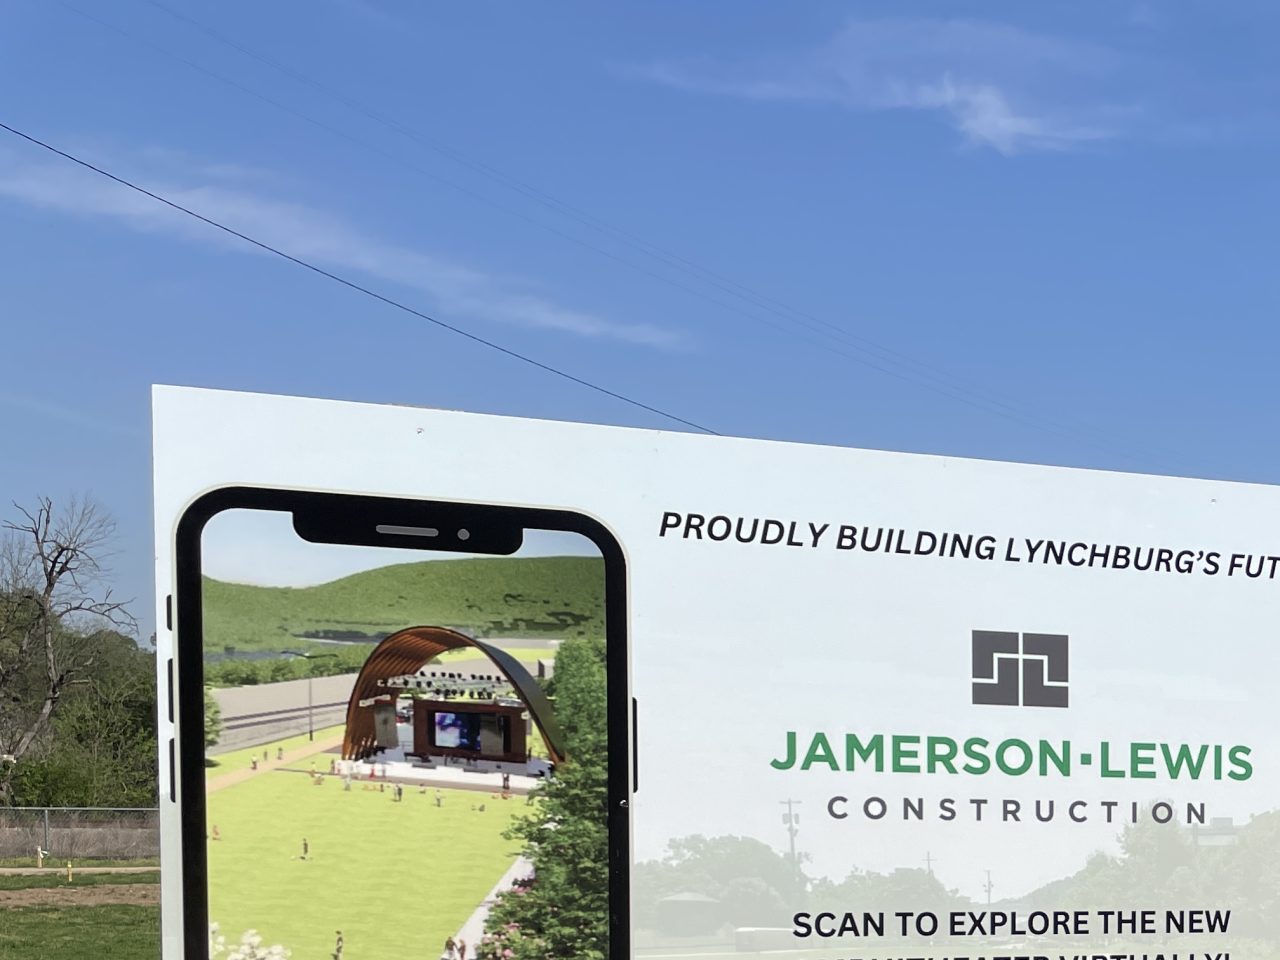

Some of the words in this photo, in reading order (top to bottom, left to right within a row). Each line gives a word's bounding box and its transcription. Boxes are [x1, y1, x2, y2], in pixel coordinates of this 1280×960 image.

[658, 511, 830, 548] PROUDLY
[835, 524, 998, 560] BUILDING
[827, 795, 1206, 825] CONSTRUCTION
[792, 912, 885, 938] SCAN
[894, 911, 939, 937] TO
[949, 910, 1090, 936] EXPLORE
[1097, 910, 1156, 934] THE
[1165, 909, 1231, 934] NEW
